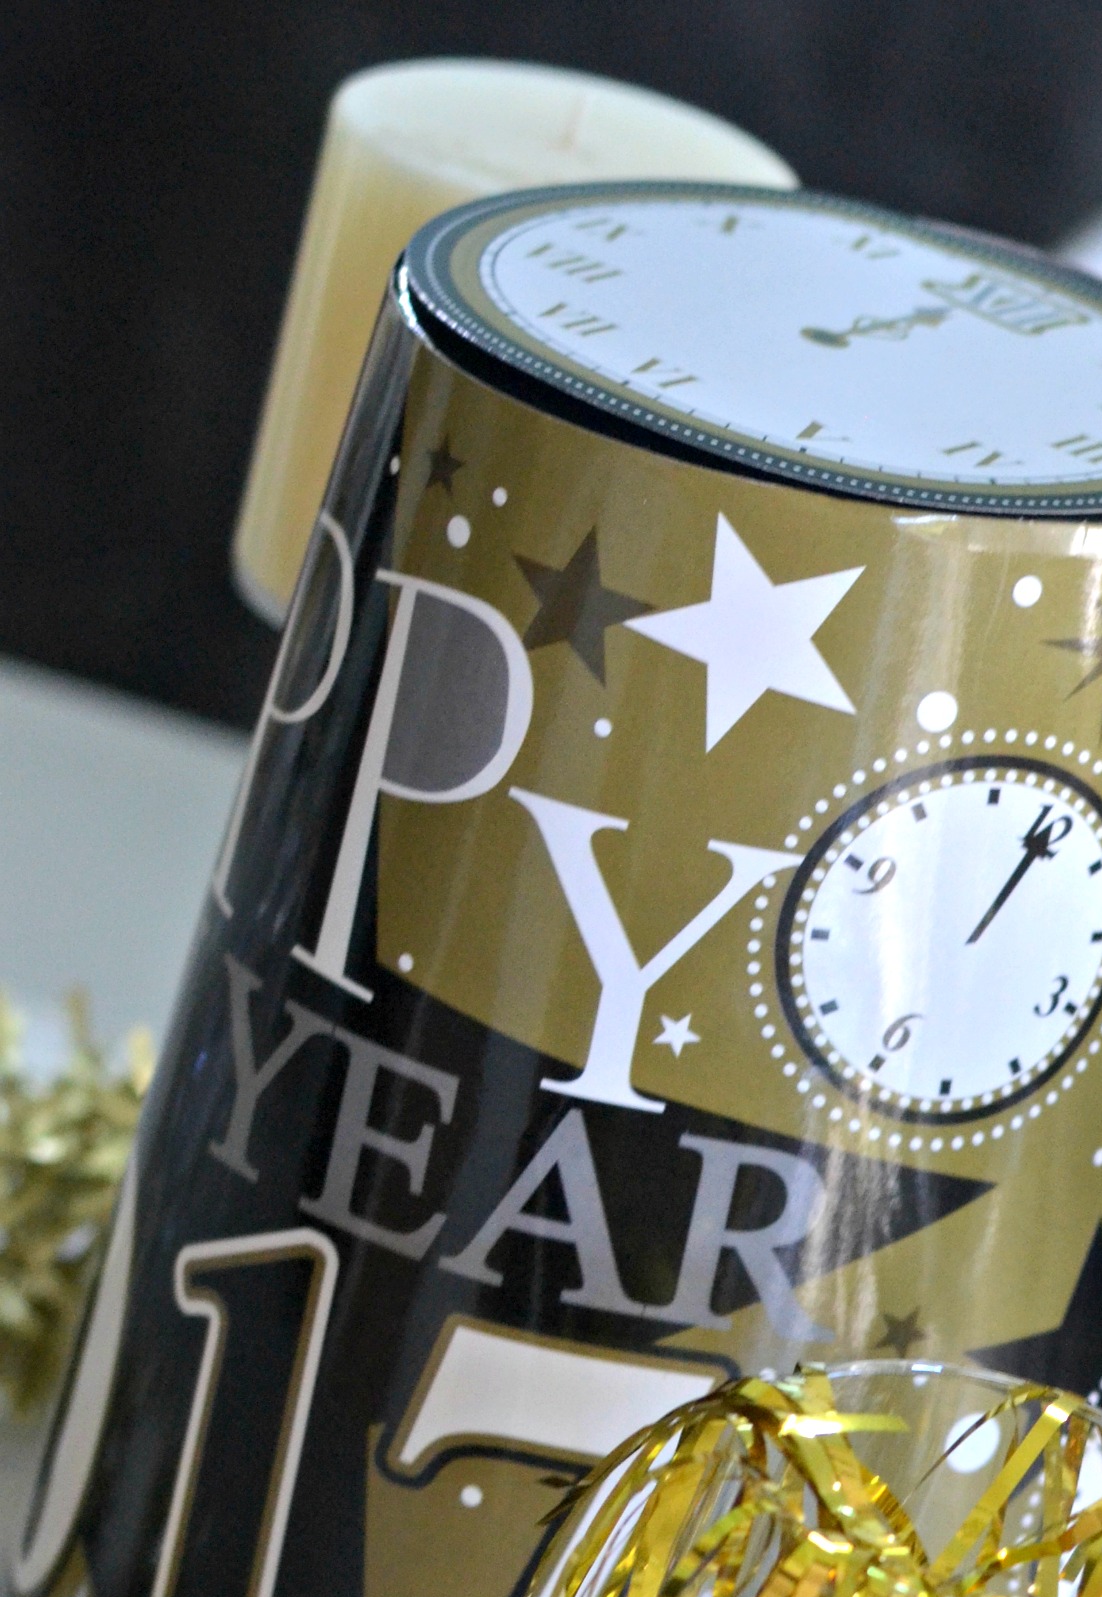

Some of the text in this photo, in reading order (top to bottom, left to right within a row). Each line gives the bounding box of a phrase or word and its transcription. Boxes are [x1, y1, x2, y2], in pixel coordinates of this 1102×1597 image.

[852, 856, 898, 896] 9
[1033, 975, 1069, 1017] 3
[881, 1012, 924, 1053] 6
[208, 950, 836, 1344] YEAR
